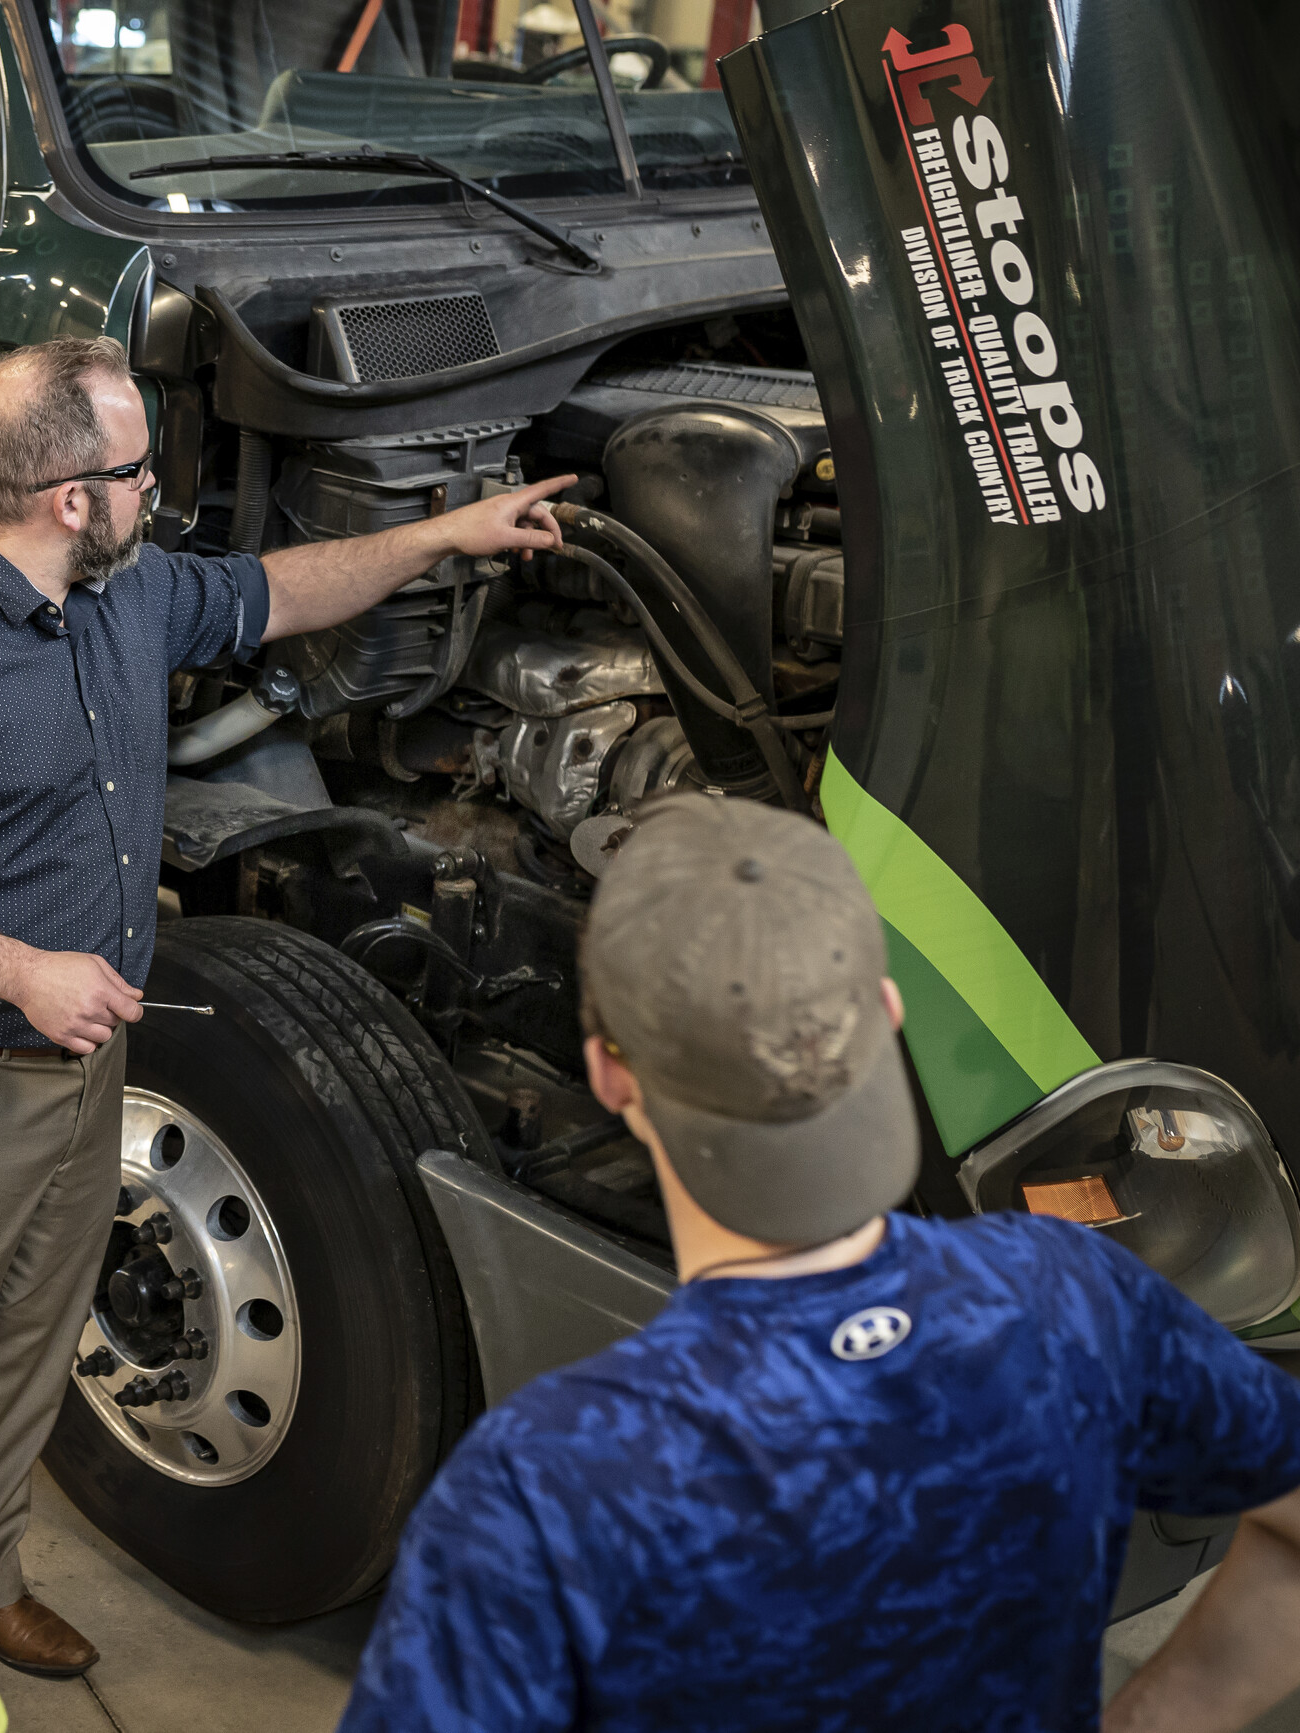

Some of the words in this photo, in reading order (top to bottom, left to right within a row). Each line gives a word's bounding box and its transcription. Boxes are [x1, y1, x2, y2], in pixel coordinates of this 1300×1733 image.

[901, 226, 951, 320] DIVISION
[953, 115, 1106, 513] Stoops
[931, 325, 960, 350] OF
[940, 356, 984, 426] TRUCK
[964, 430, 1019, 525] COUNTRY
[1003, 422, 1062, 524] TRAILER
